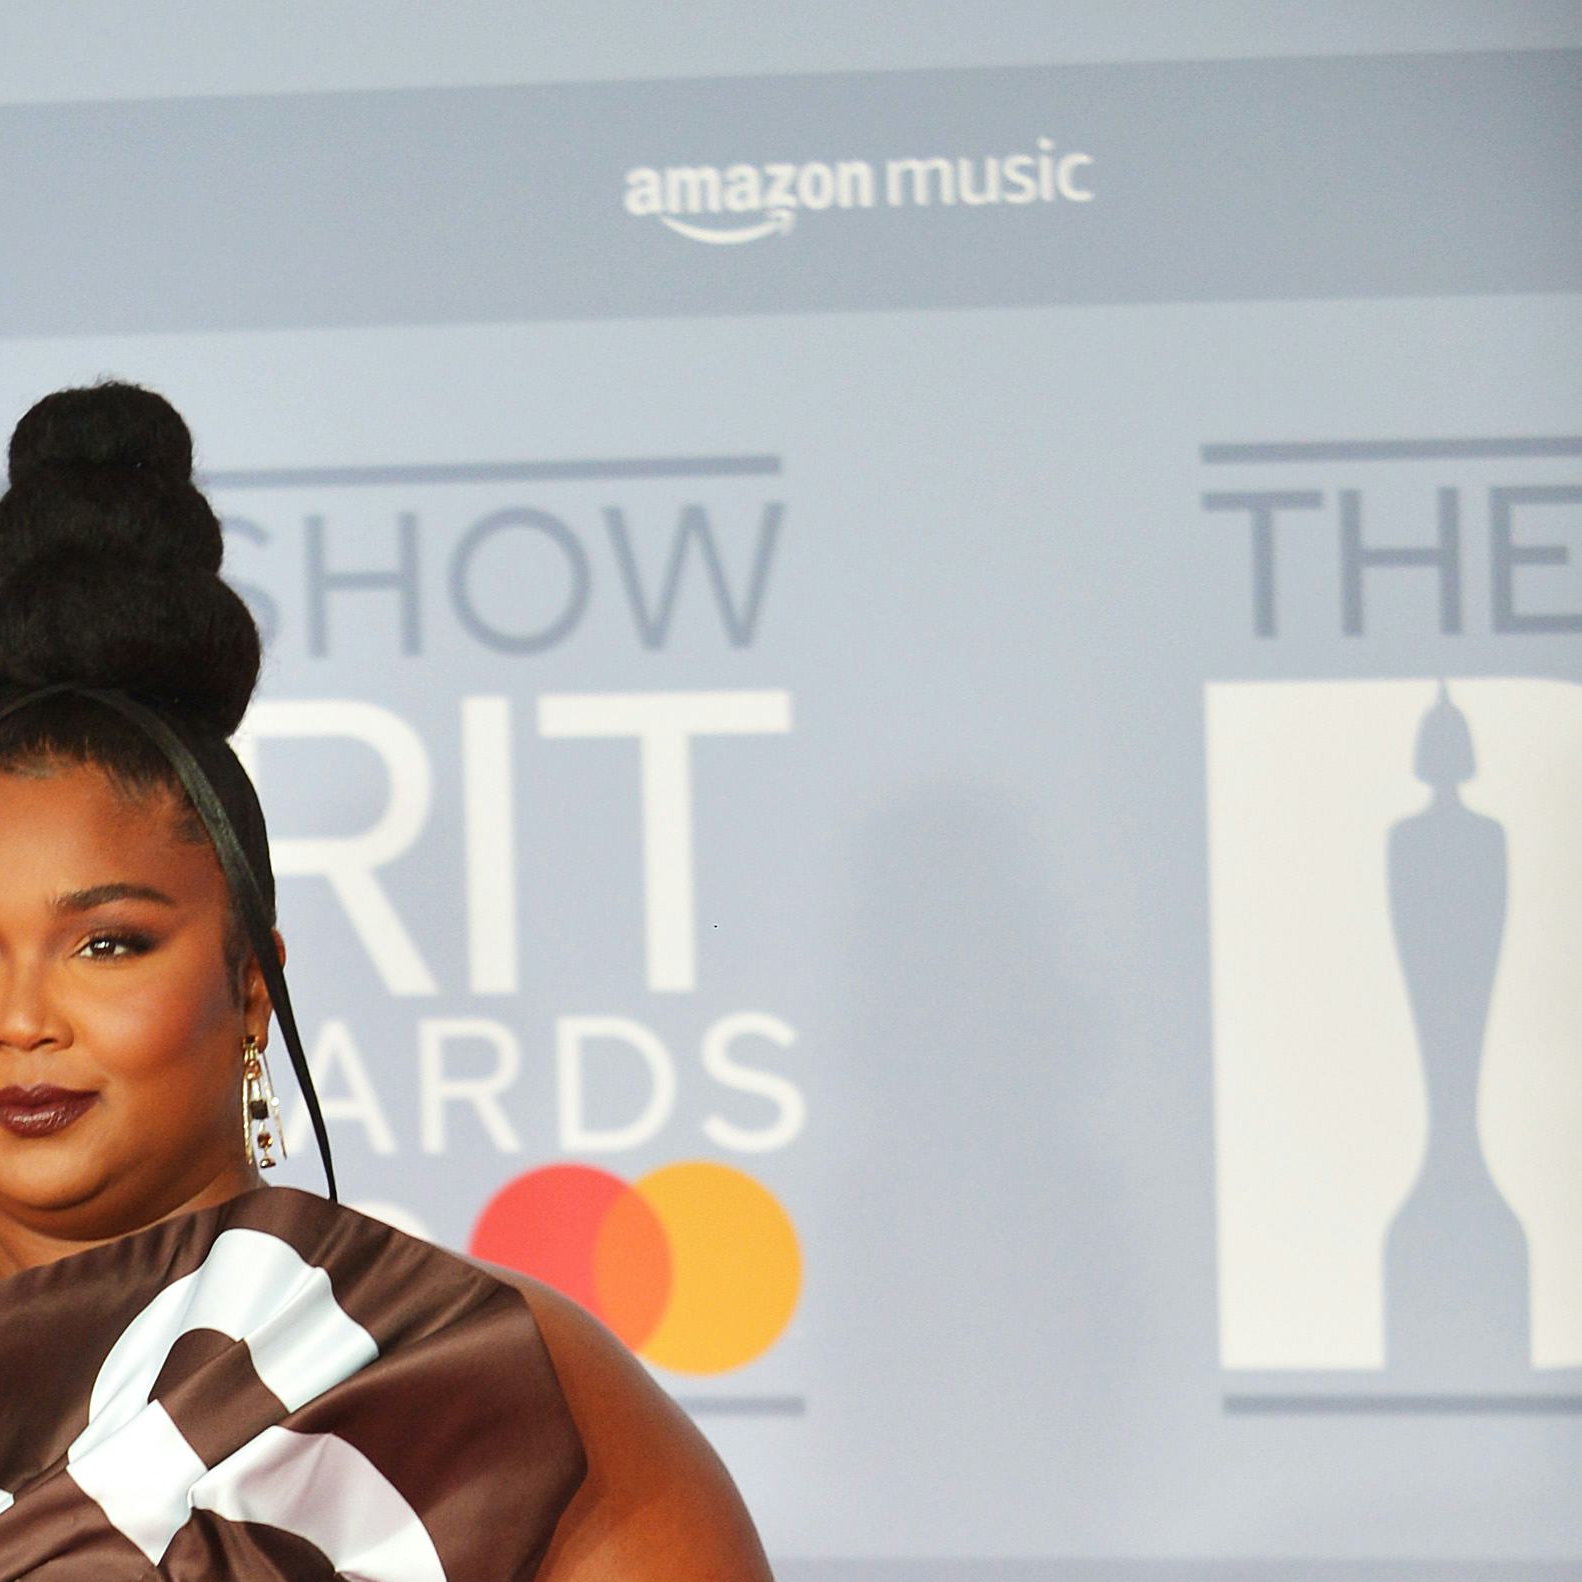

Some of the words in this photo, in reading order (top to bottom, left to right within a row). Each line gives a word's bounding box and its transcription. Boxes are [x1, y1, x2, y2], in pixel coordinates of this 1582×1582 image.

[624, 160, 875, 220] amazon
[886, 138, 1095, 205] music
[1201, 485, 1582, 640] THE
[226, 690, 792, 998] RIT
[286, 1010, 807, 1156] ARDS
